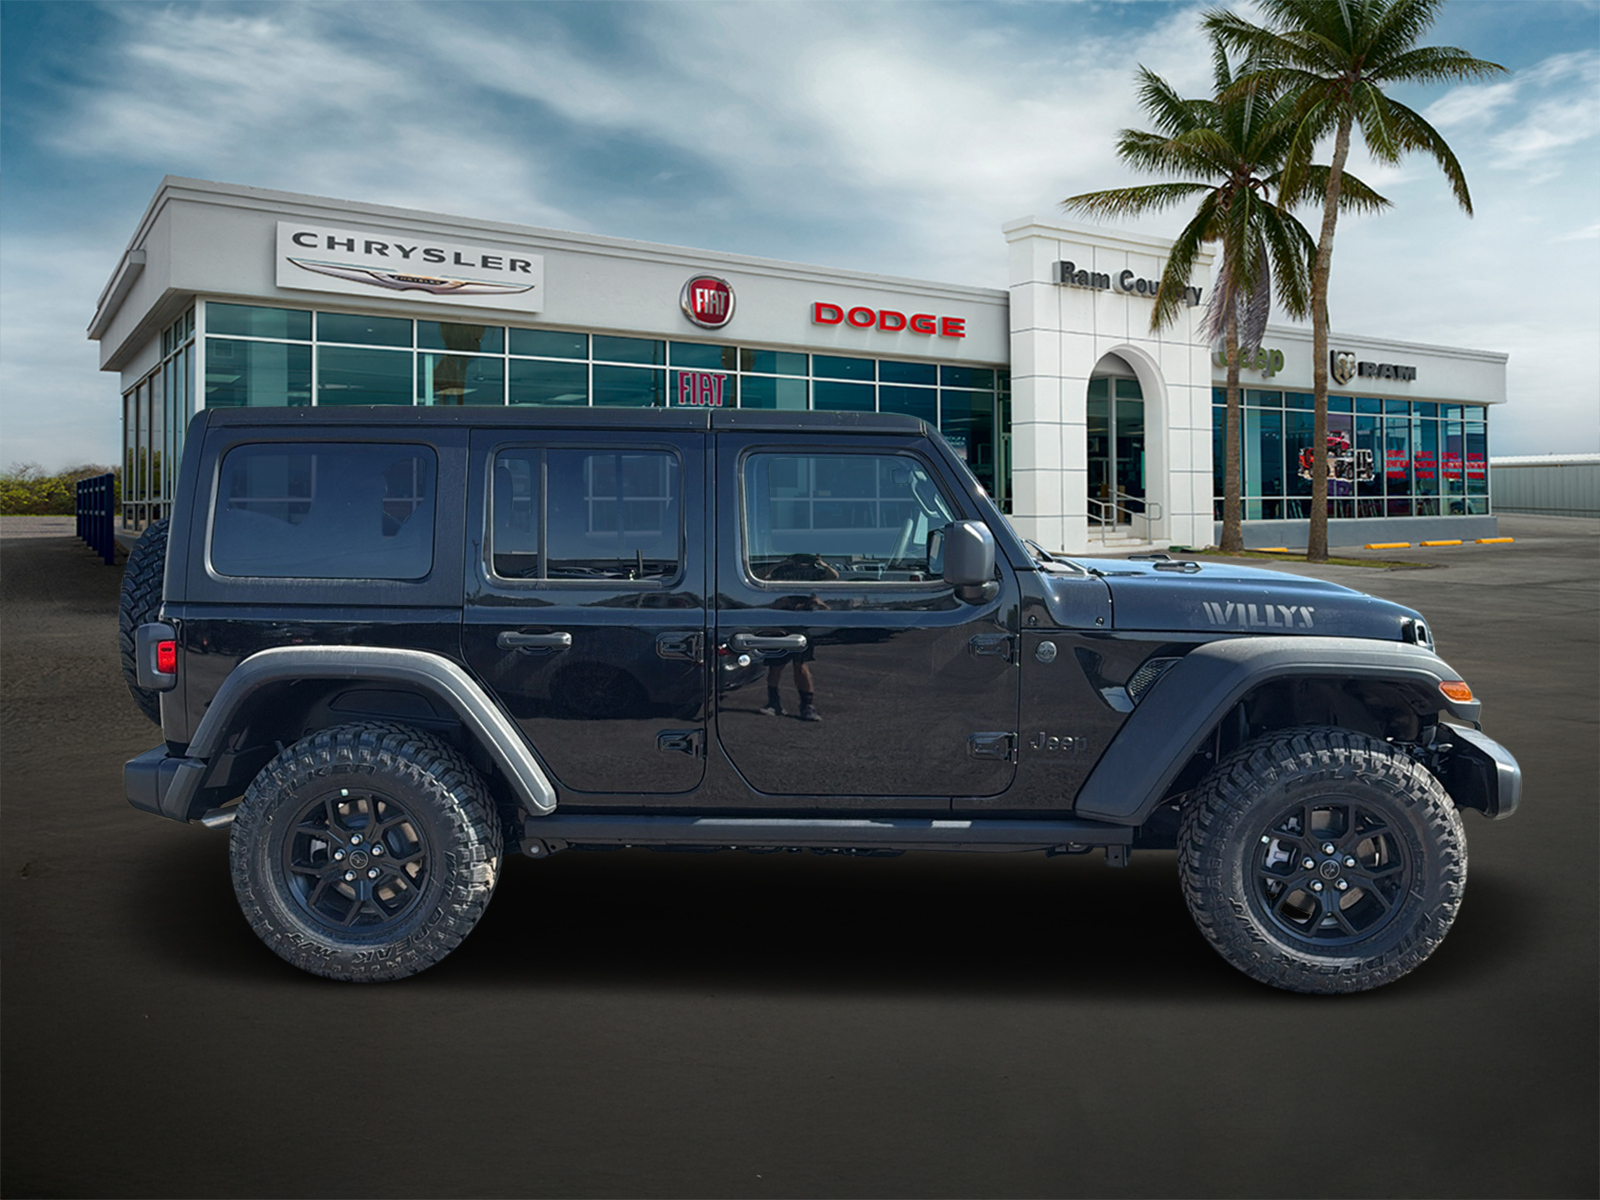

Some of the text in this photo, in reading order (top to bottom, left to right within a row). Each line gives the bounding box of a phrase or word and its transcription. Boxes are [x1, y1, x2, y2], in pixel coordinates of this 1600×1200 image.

[292, 232, 532, 273] CHRYSLER
[1055, 260, 1202, 306] Ram Coury
[695, 288, 727, 316] FIAT
[813, 302, 966, 338] DODGE
[1358, 362, 1416, 381] RAM
[678, 371, 727, 406] FIAT
[1202, 601, 1315, 629] WILLYS
[1030, 731, 1088, 755] Jeep
